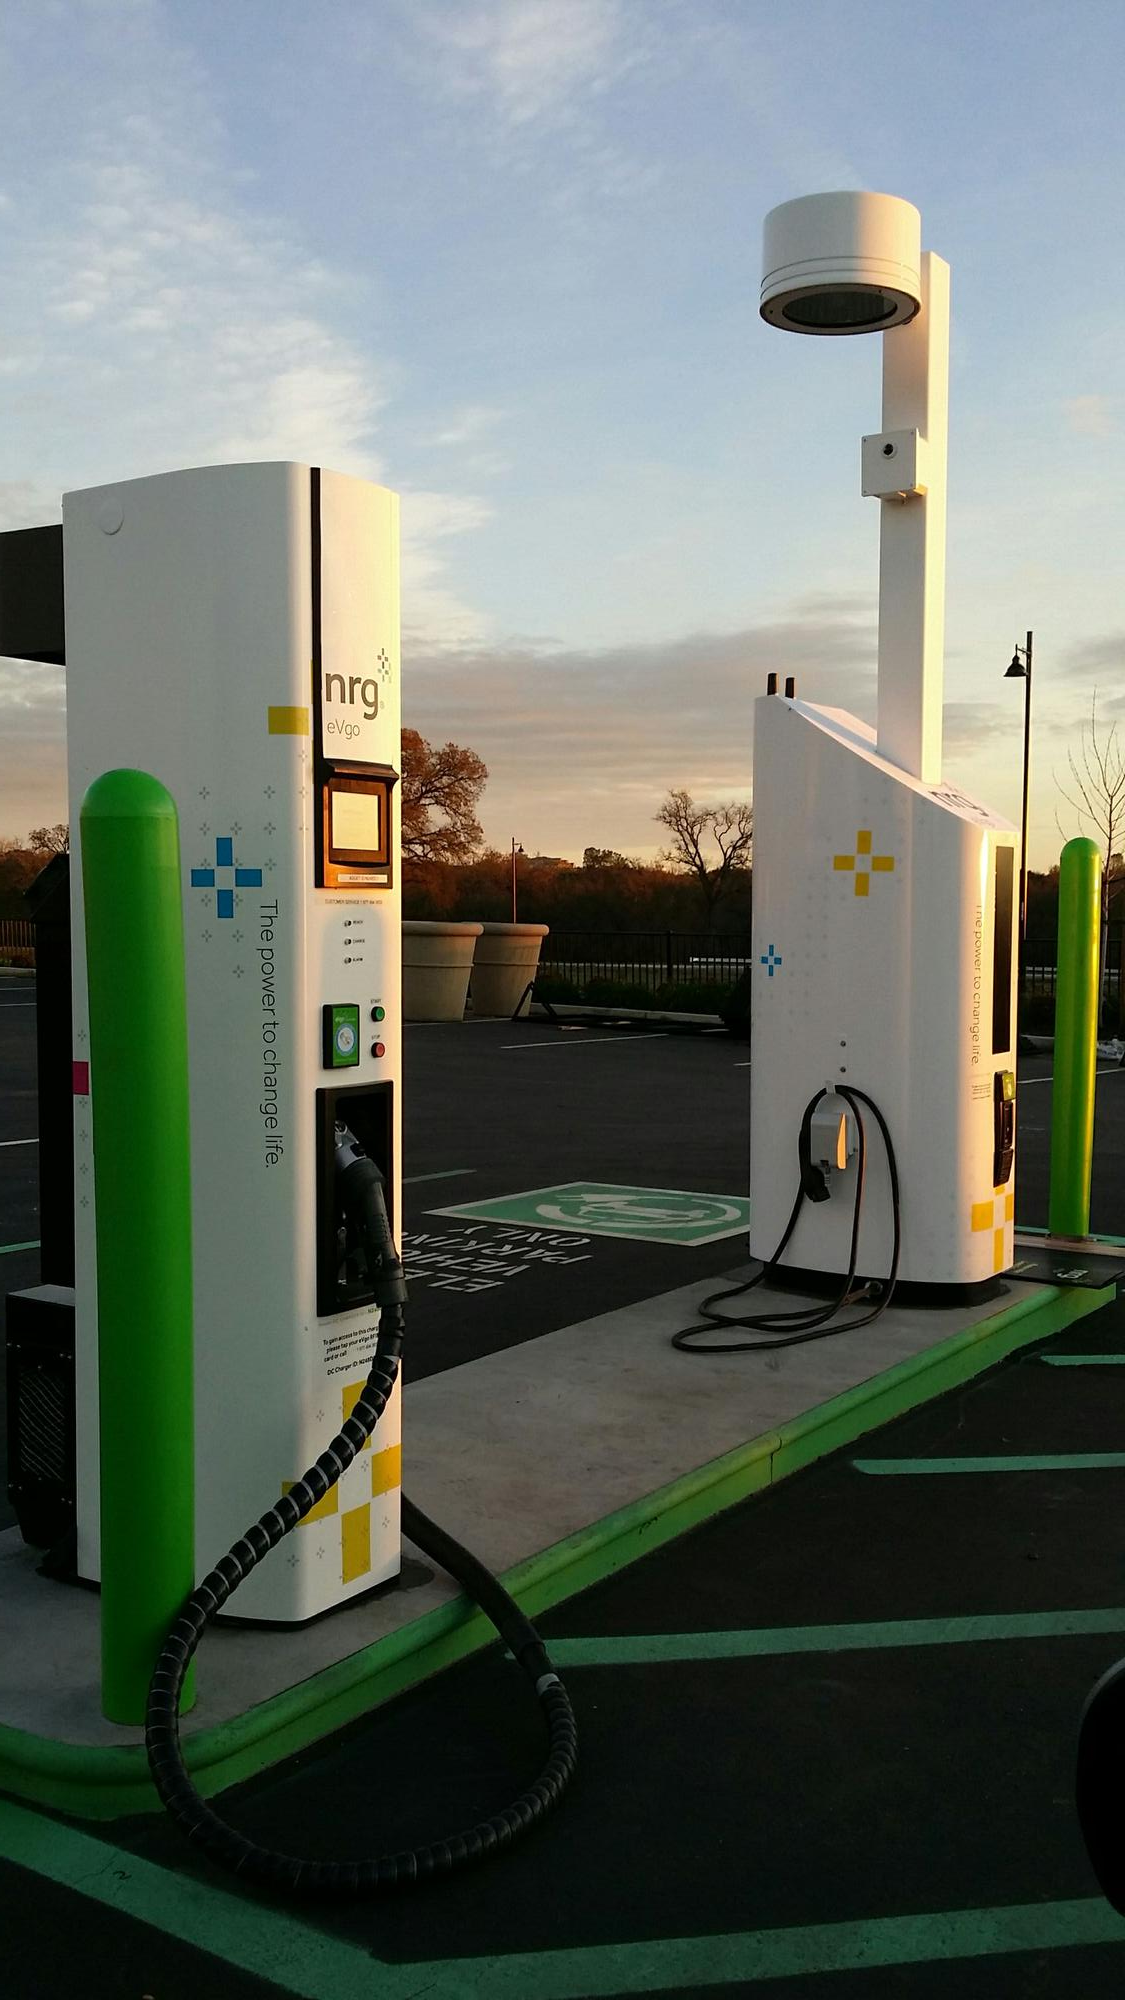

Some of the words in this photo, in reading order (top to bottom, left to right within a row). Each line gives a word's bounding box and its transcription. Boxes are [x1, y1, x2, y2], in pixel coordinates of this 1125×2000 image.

[325, 673, 379, 720] nrg
[327, 719, 360, 740] eVgo
[260, 899, 279, 942] The
[973, 931, 983, 972] power
[256, 948, 277, 1016] power
[972, 976, 982, 990] to
[262, 1020, 280, 1044] to
[969, 992, 981, 1042] change
[259, 1049, 282, 1129] change
[265, 1135, 284, 1169] life.
[402, 1231, 593, 1265] PARKIN
[445, 1225, 591, 1247] ONLY
[402, 1268, 505, 1293] ELE
[326, 1344, 340, 1354] please
[335, 1363, 352, 1373] Charger
